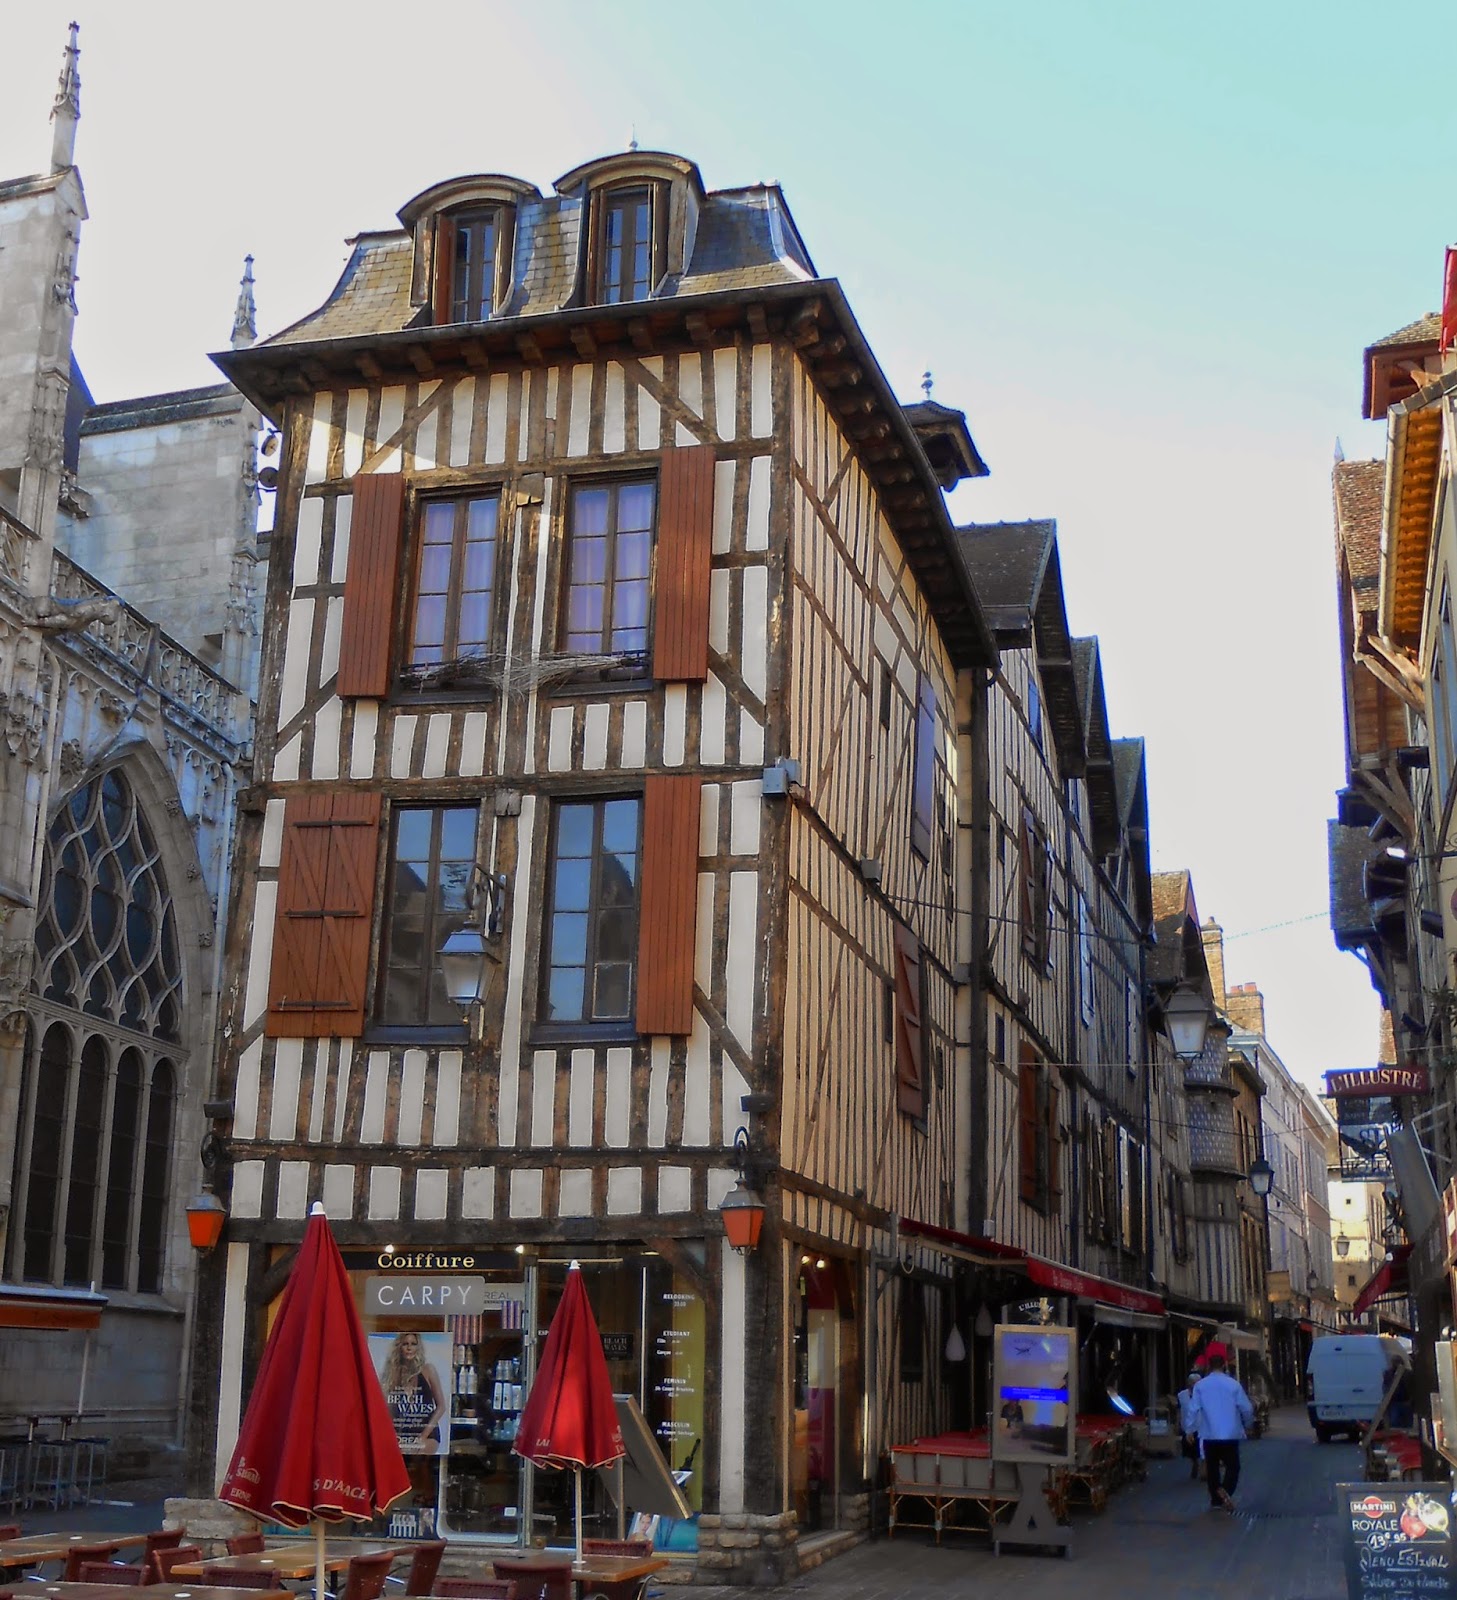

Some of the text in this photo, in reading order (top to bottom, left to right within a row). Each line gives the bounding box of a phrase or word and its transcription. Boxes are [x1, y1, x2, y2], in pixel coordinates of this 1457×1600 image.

[1330, 1069, 1422, 1092] L'ILLUSTRÉ
[377, 1253, 475, 1268] Coiffure
[377, 1285, 472, 1306] CARPY
[387, 1394, 424, 1404] BEACH
[397, 1403, 434, 1413] WAVES
[1353, 1503, 1394, 1511] MARTINI
[1352, 1520, 1398, 1531] ROYALE
